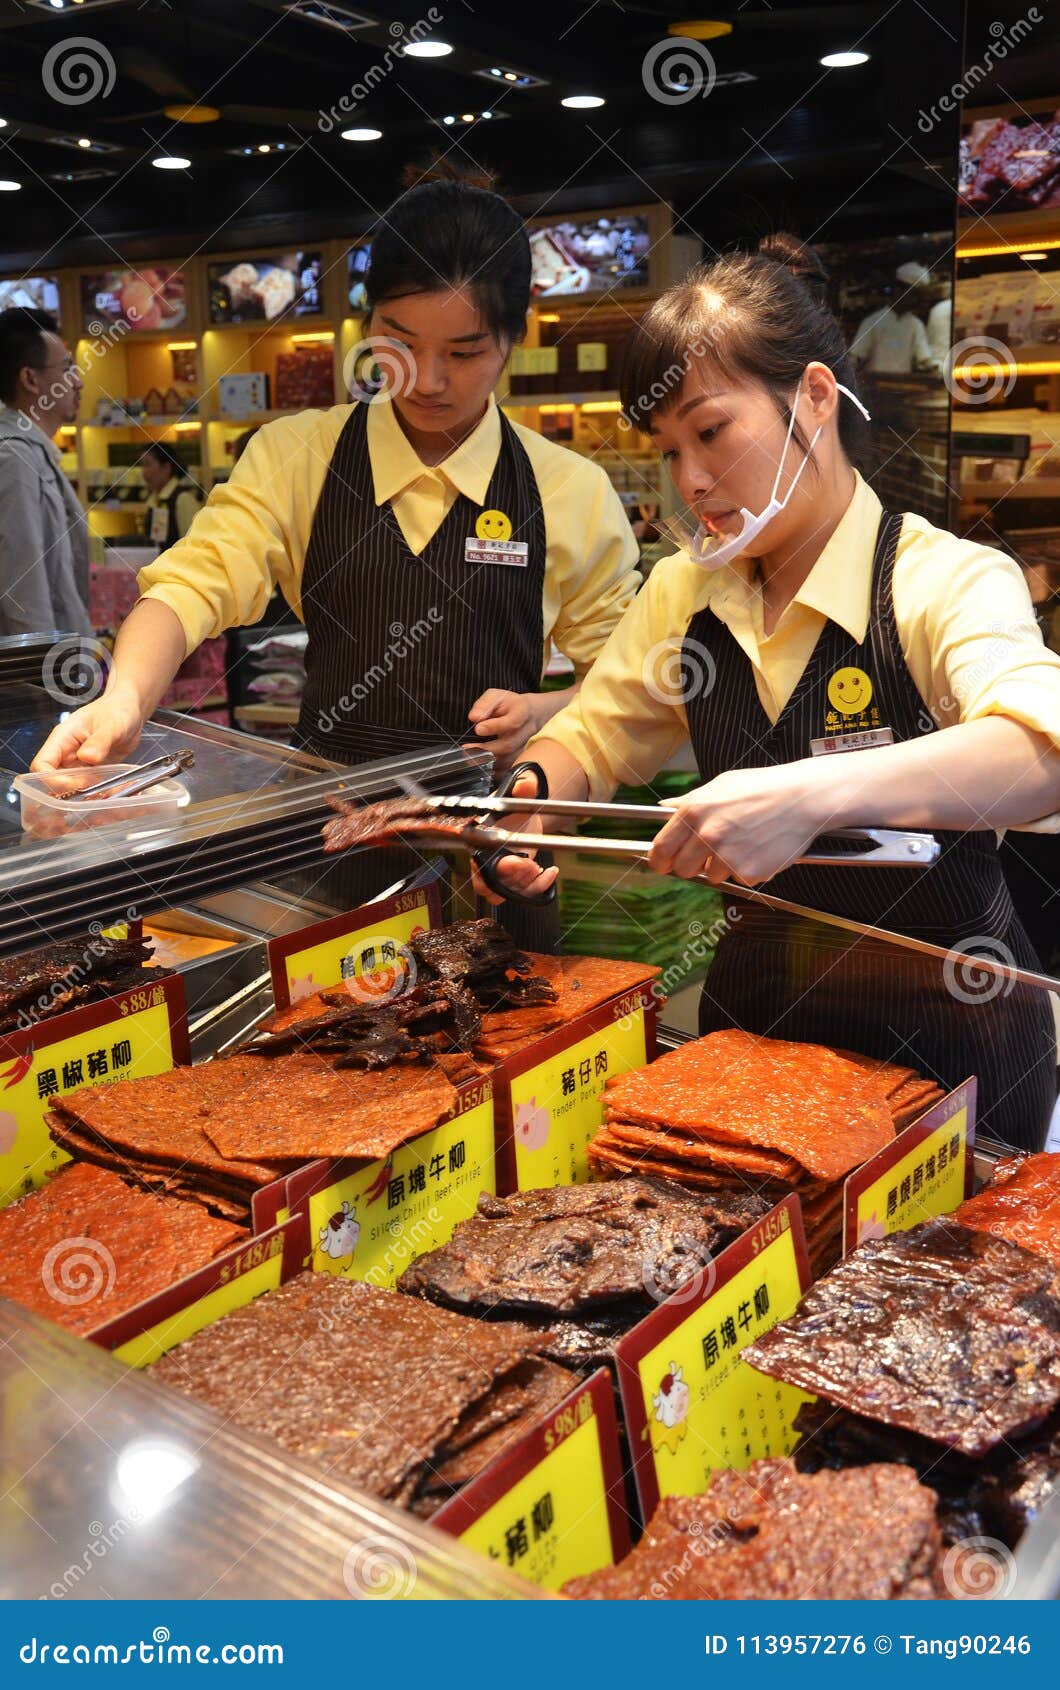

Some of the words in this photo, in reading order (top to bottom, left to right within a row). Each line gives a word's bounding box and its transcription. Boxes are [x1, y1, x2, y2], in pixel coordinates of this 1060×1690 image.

[119, 985, 166, 1016] $88/磅
[36, 1039, 133, 1100] 黑椒豬柳
[561, 1050, 608, 1096] 豬仔肉
[387, 1140, 466, 1210] 原塊牛柳
[751, 1206, 791, 1255] $145/磅
[701, 1283, 770, 1371] 原塊牛柳
[488, 1490, 554, 1567] 豬柳
